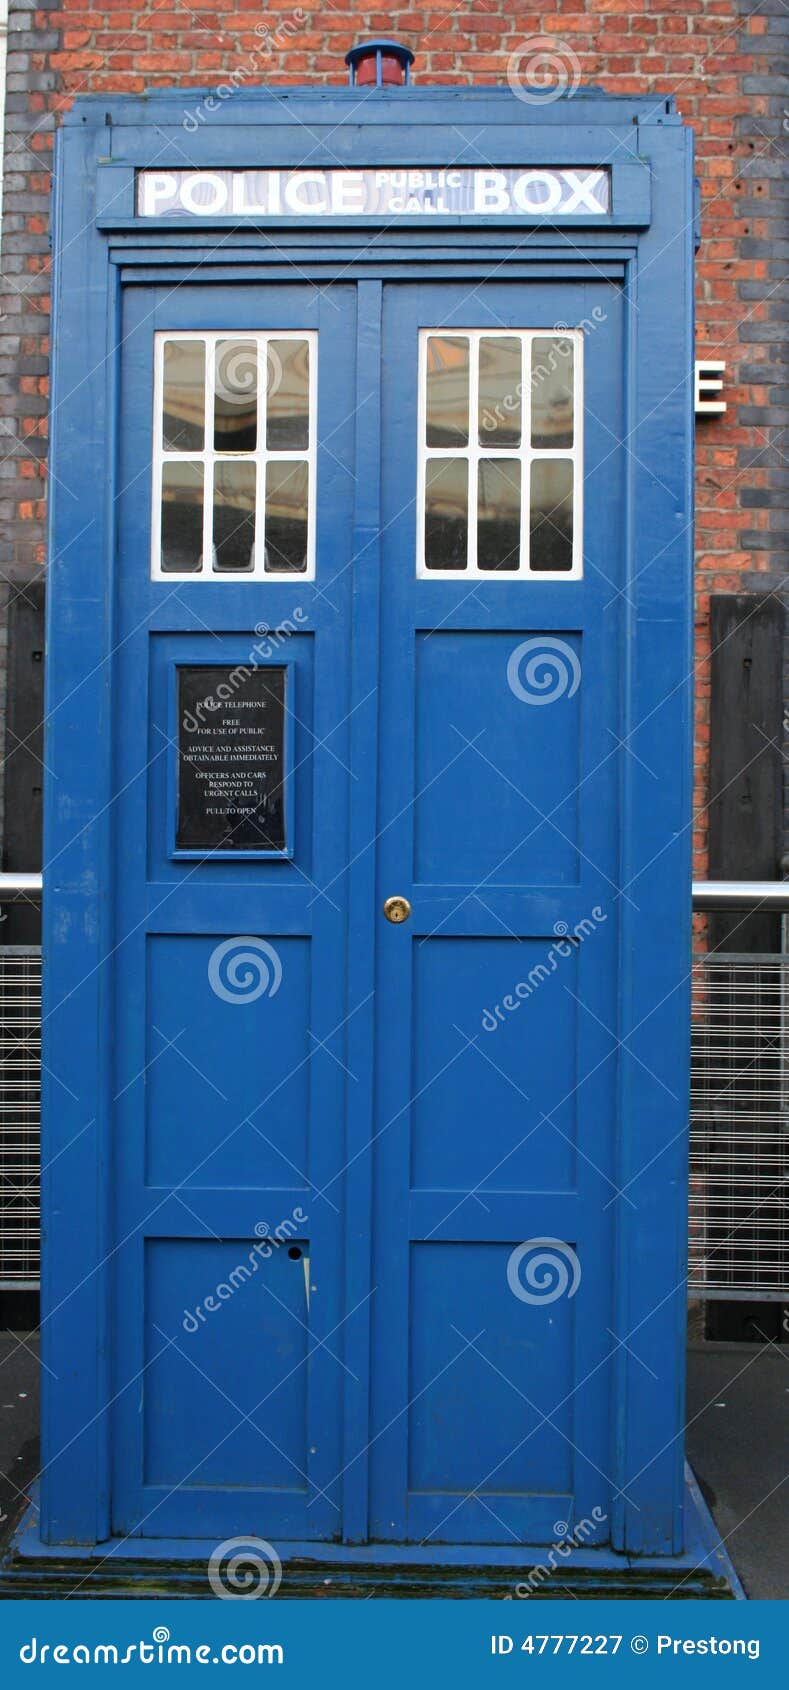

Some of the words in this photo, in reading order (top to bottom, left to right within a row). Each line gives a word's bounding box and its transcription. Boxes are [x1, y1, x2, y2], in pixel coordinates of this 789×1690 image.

[375, 172, 462, 188] PUBLIC
[144, 172, 364, 216] POLICE
[474, 171, 608, 214] BOX
[388, 197, 450, 213] CALL
[196, 701, 223, 709] POLICE
[225, 701, 267, 709] TELEPHONE
[239, 727, 266, 735] PUBLIC
[188, 745, 215, 753] ADVICE
[216, 745, 232, 753] AND
[183, 754, 229, 762] OBTAINABLE
[206, 807, 225, 815] PULL
[225, 807, 236, 815] TO
[236, 807, 257, 815] OPEN
